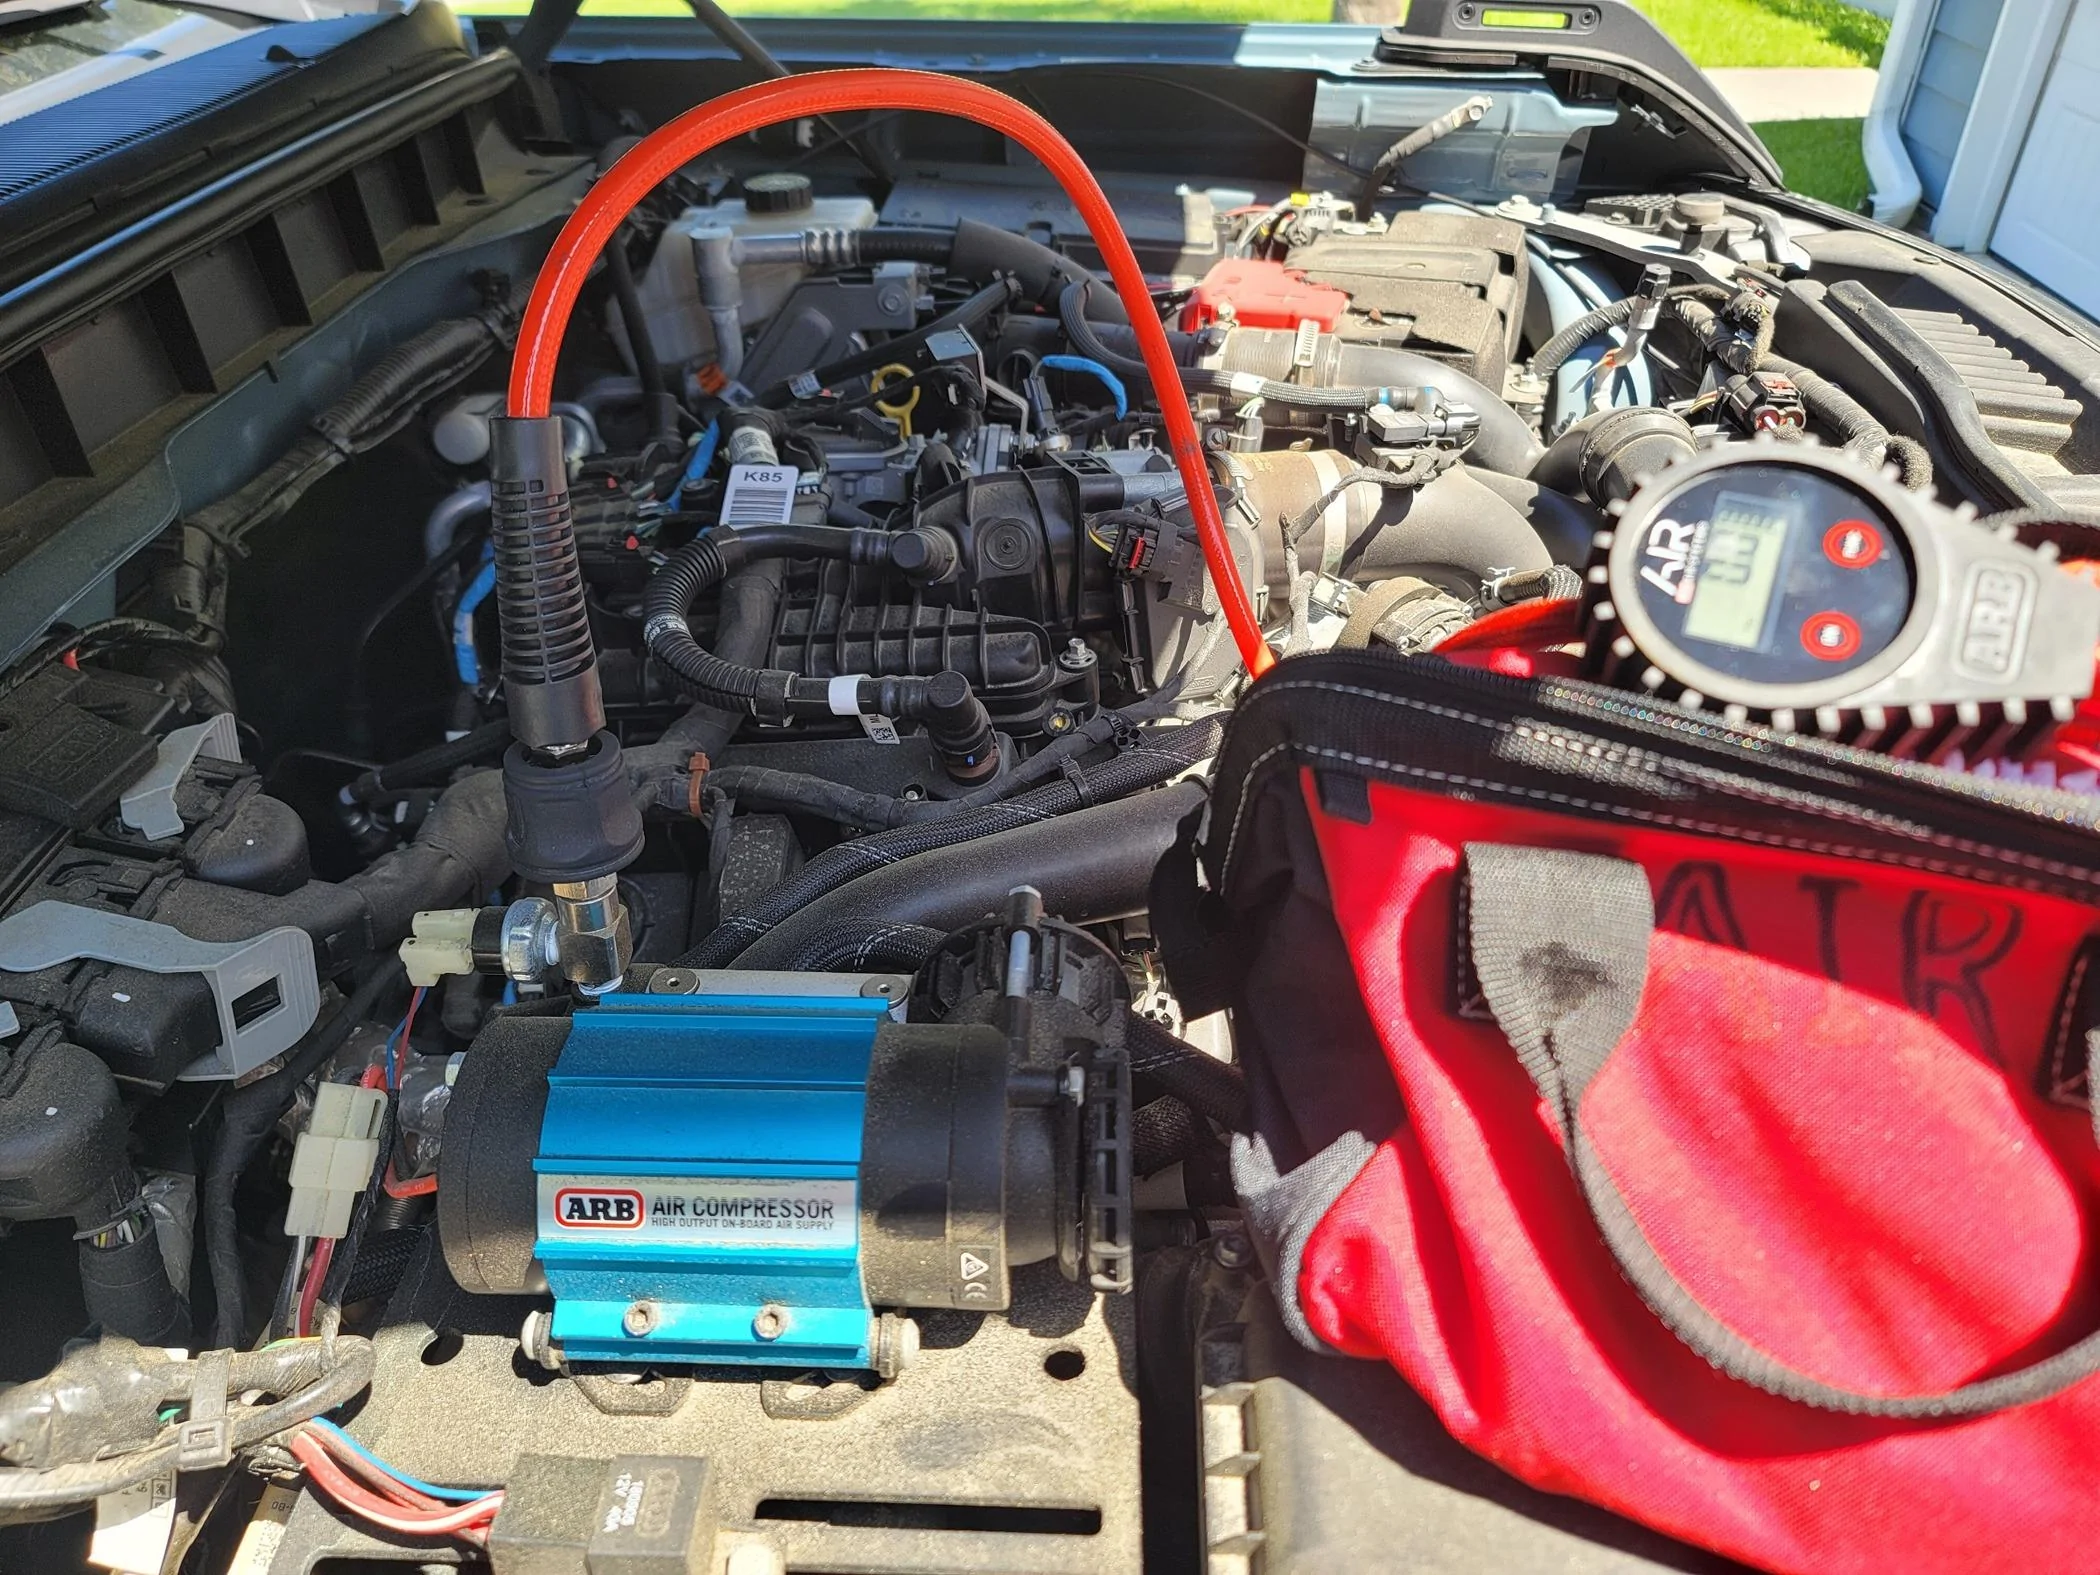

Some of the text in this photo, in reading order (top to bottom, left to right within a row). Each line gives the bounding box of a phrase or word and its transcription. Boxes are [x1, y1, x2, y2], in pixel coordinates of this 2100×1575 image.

[743, 471, 784, 483] K85
[1961, 568, 2025, 674] ARB
[1654, 860, 2024, 1063] AIR
[565, 1196, 636, 1222] ARB
[652, 1196, 834, 1219] AIR COMPRESSOR
[651, 1217, 834, 1231] HIGH OUTPUT ON-BOARD AIR SUPPLY
